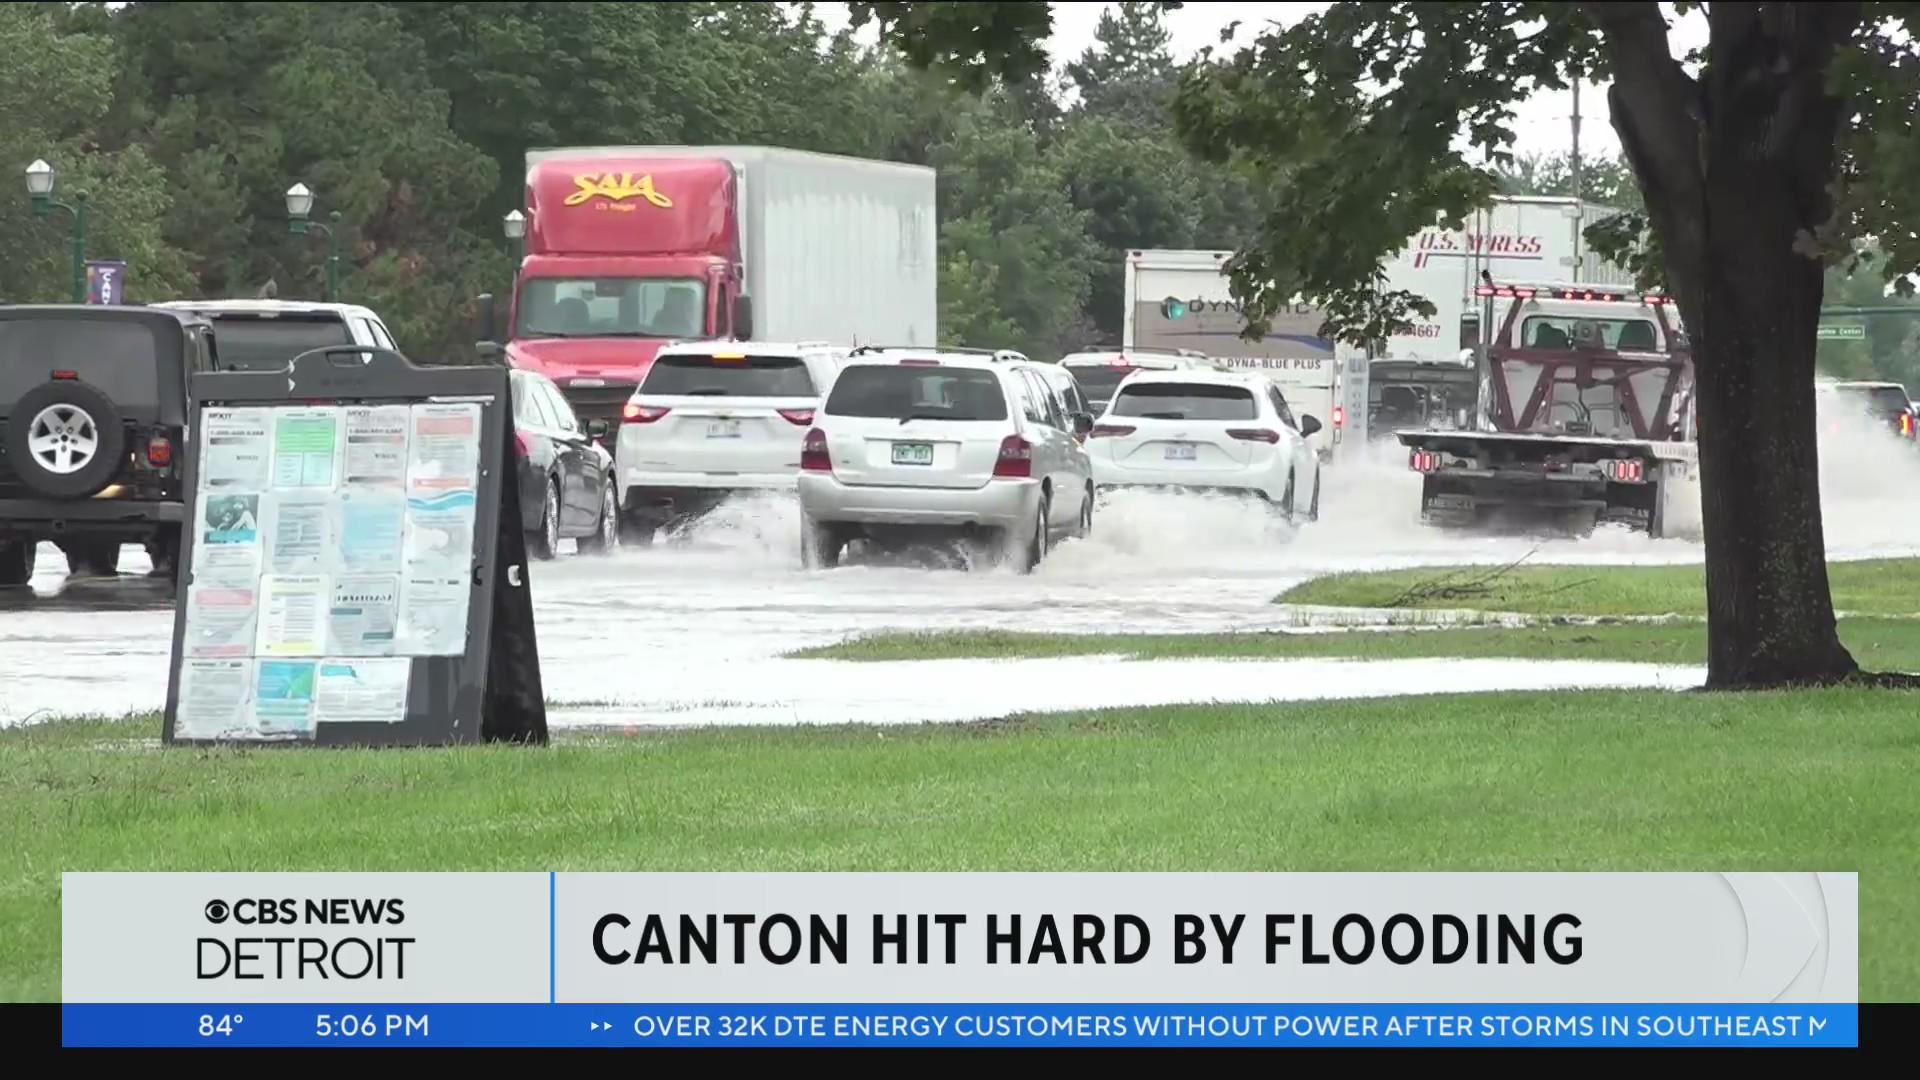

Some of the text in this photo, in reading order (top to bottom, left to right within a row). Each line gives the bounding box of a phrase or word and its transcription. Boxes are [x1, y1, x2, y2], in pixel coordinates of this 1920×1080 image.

[563, 173, 674, 207] SAIA
[1420, 233, 1458, 250] U.S.
[1226, 358, 1321, 370] DYNA-BLUE PLUS
